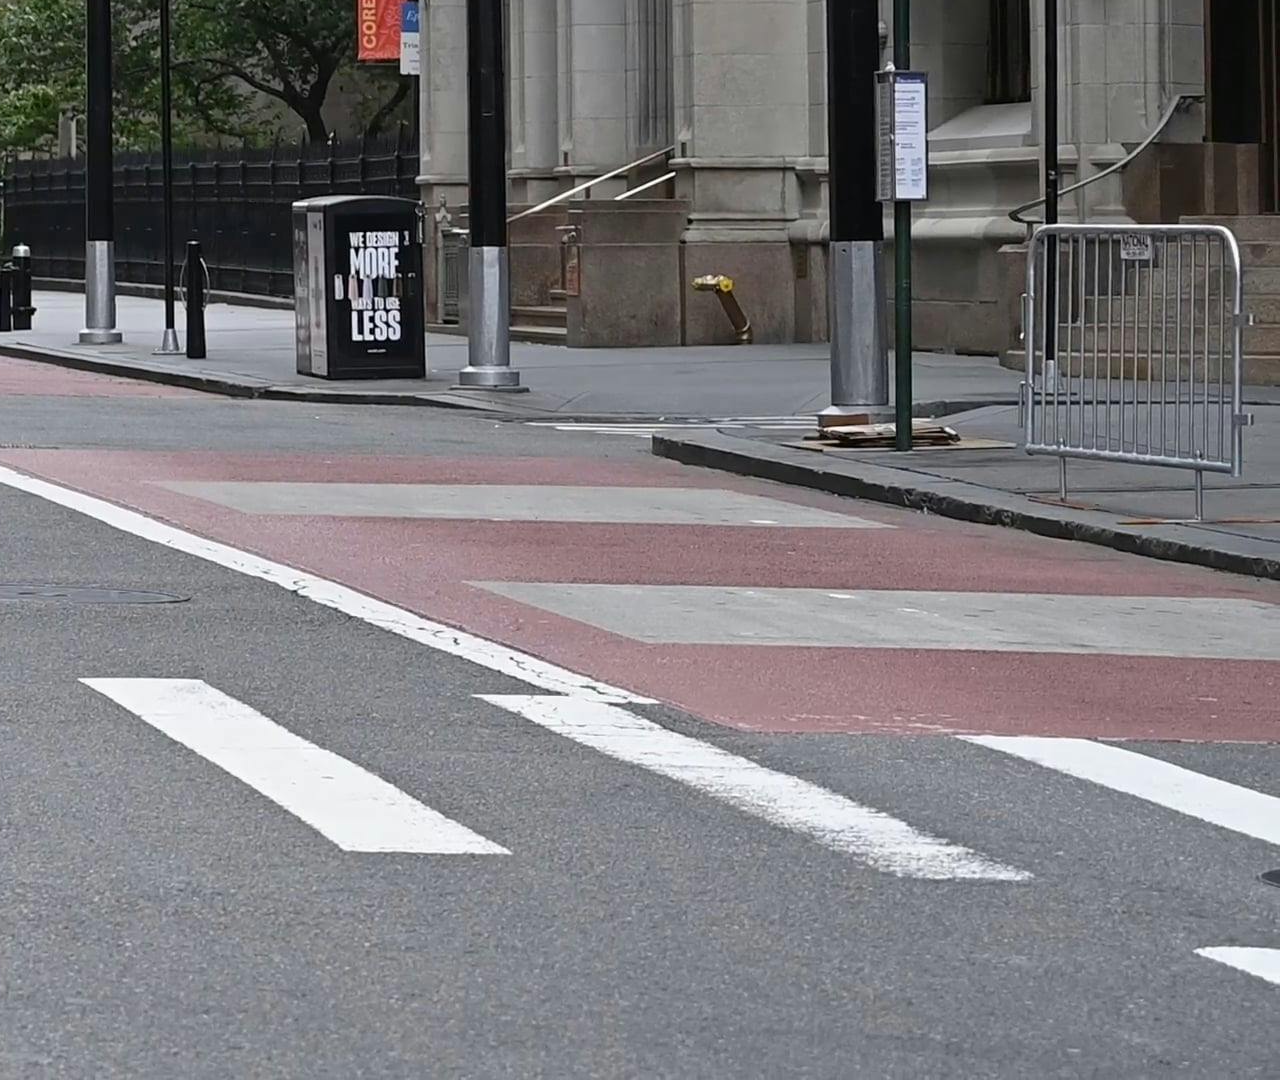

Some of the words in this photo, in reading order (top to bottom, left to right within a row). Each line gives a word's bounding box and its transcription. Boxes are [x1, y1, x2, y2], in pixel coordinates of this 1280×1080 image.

[349, 231, 364, 247] WE
[366, 231, 399, 247] DESIGN
[349, 247, 400, 280] MORE
[374, 297, 384, 310] TO
[385, 296, 400, 310] USE
[351, 310, 402, 341] LESS
